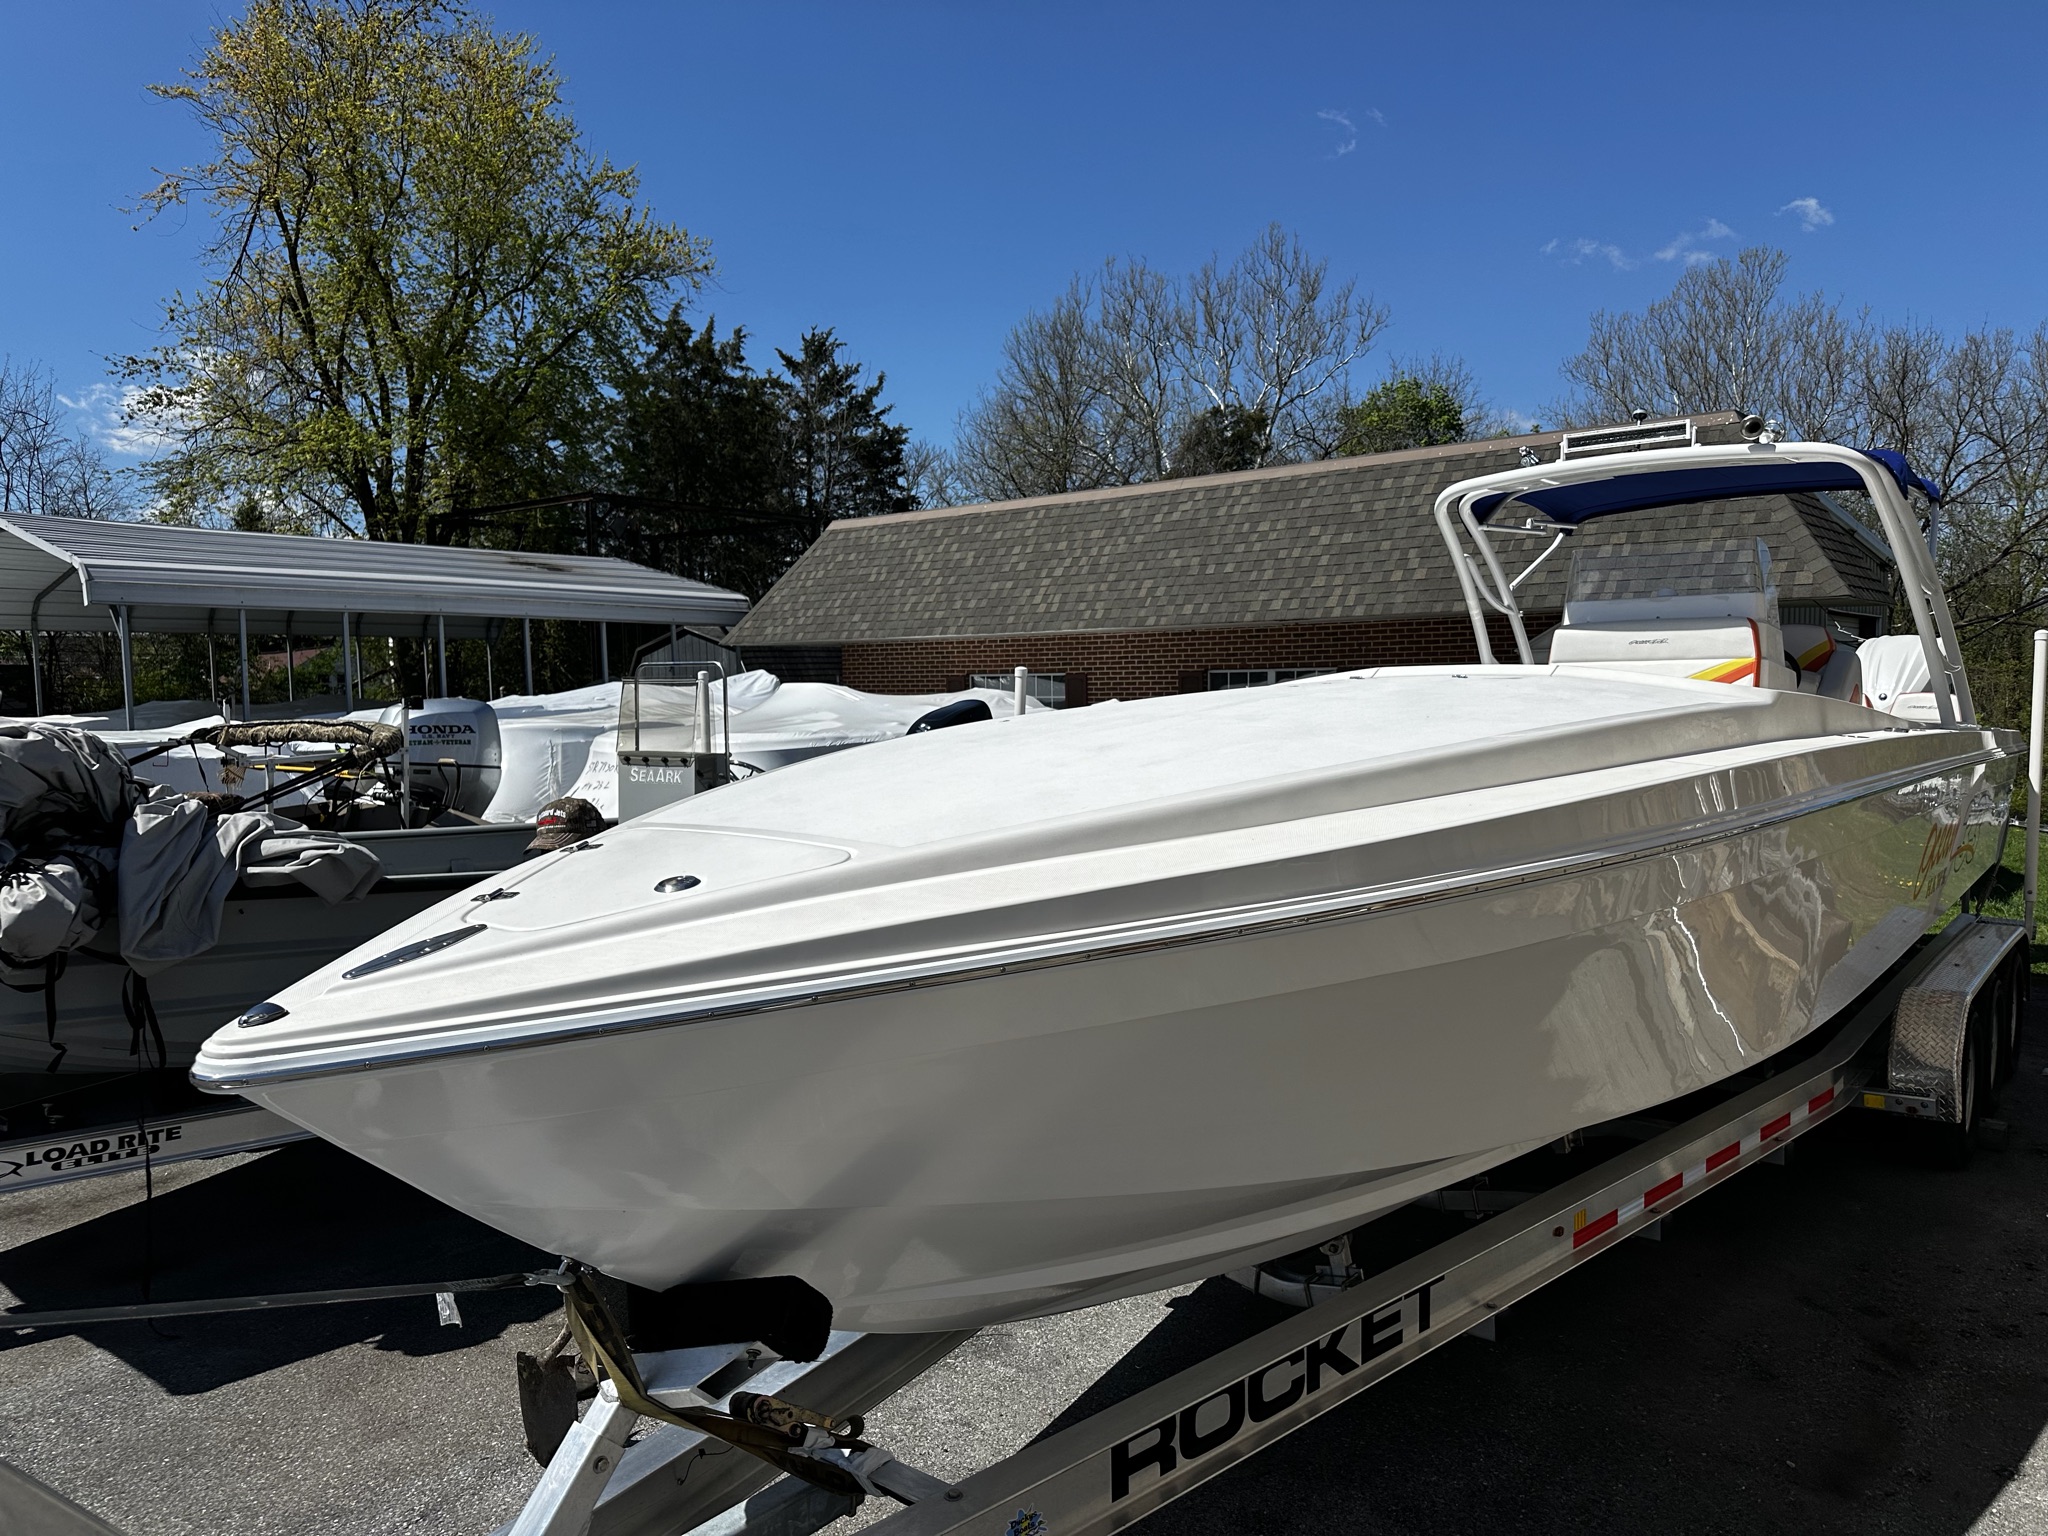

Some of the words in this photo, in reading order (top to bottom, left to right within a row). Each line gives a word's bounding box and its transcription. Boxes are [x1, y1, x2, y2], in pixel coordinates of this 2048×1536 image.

[26, 1139, 110, 1167] LOAD
[118, 1126, 182, 1150] RITE
[56, 1145, 156, 1171] ELITE
[1111, 1275, 1445, 1504] ROCKET
